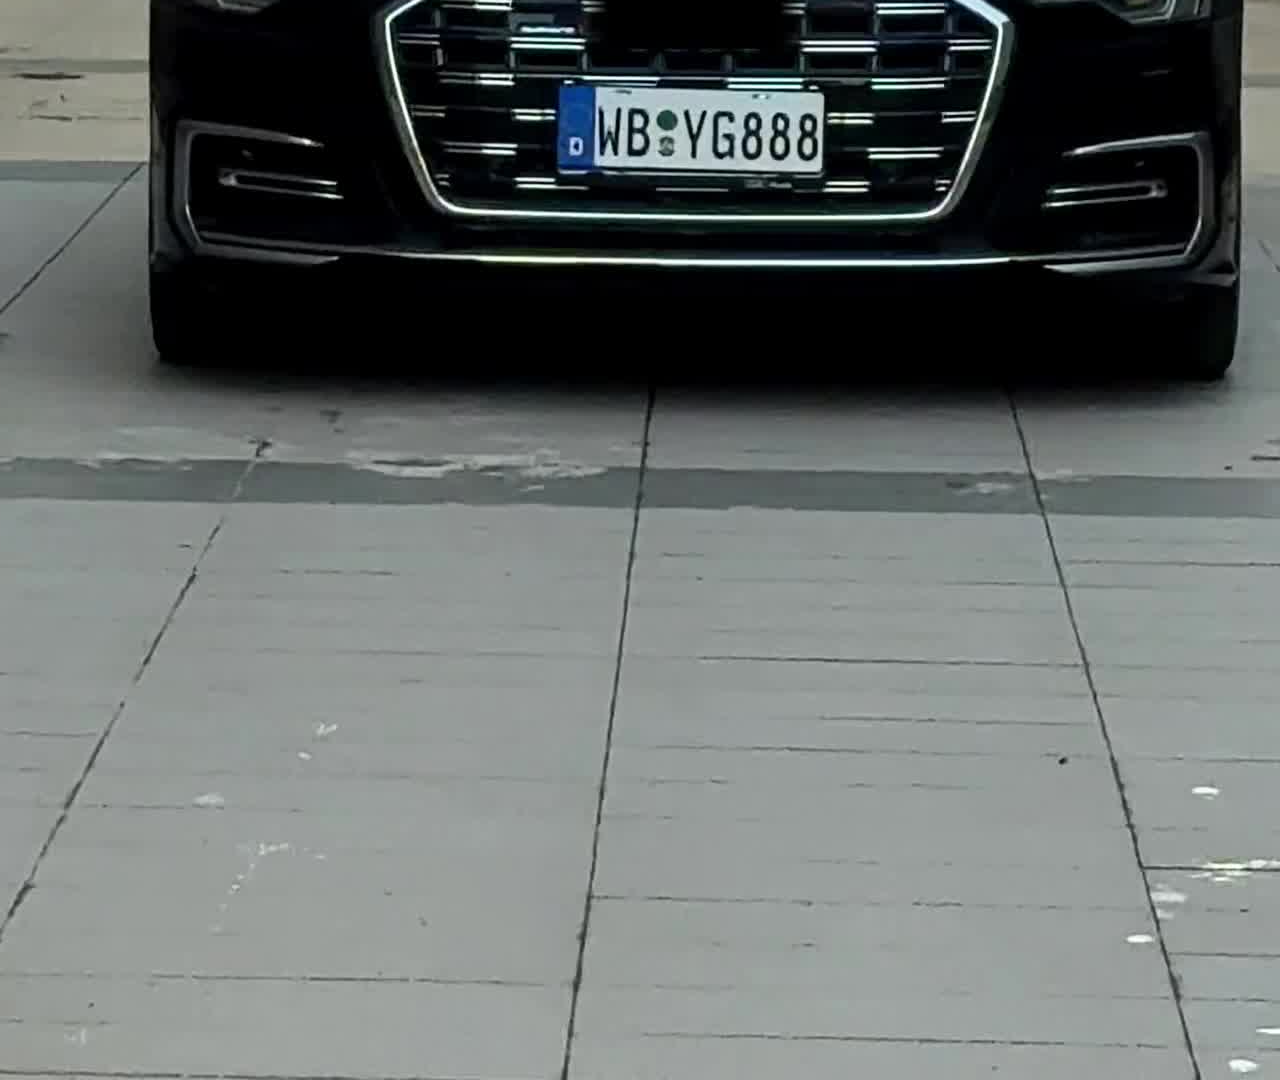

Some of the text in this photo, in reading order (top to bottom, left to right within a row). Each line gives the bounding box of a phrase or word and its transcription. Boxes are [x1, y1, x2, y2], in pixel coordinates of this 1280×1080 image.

[570, 137, 584, 155] D
[598, 107, 819, 161] WB YG888
